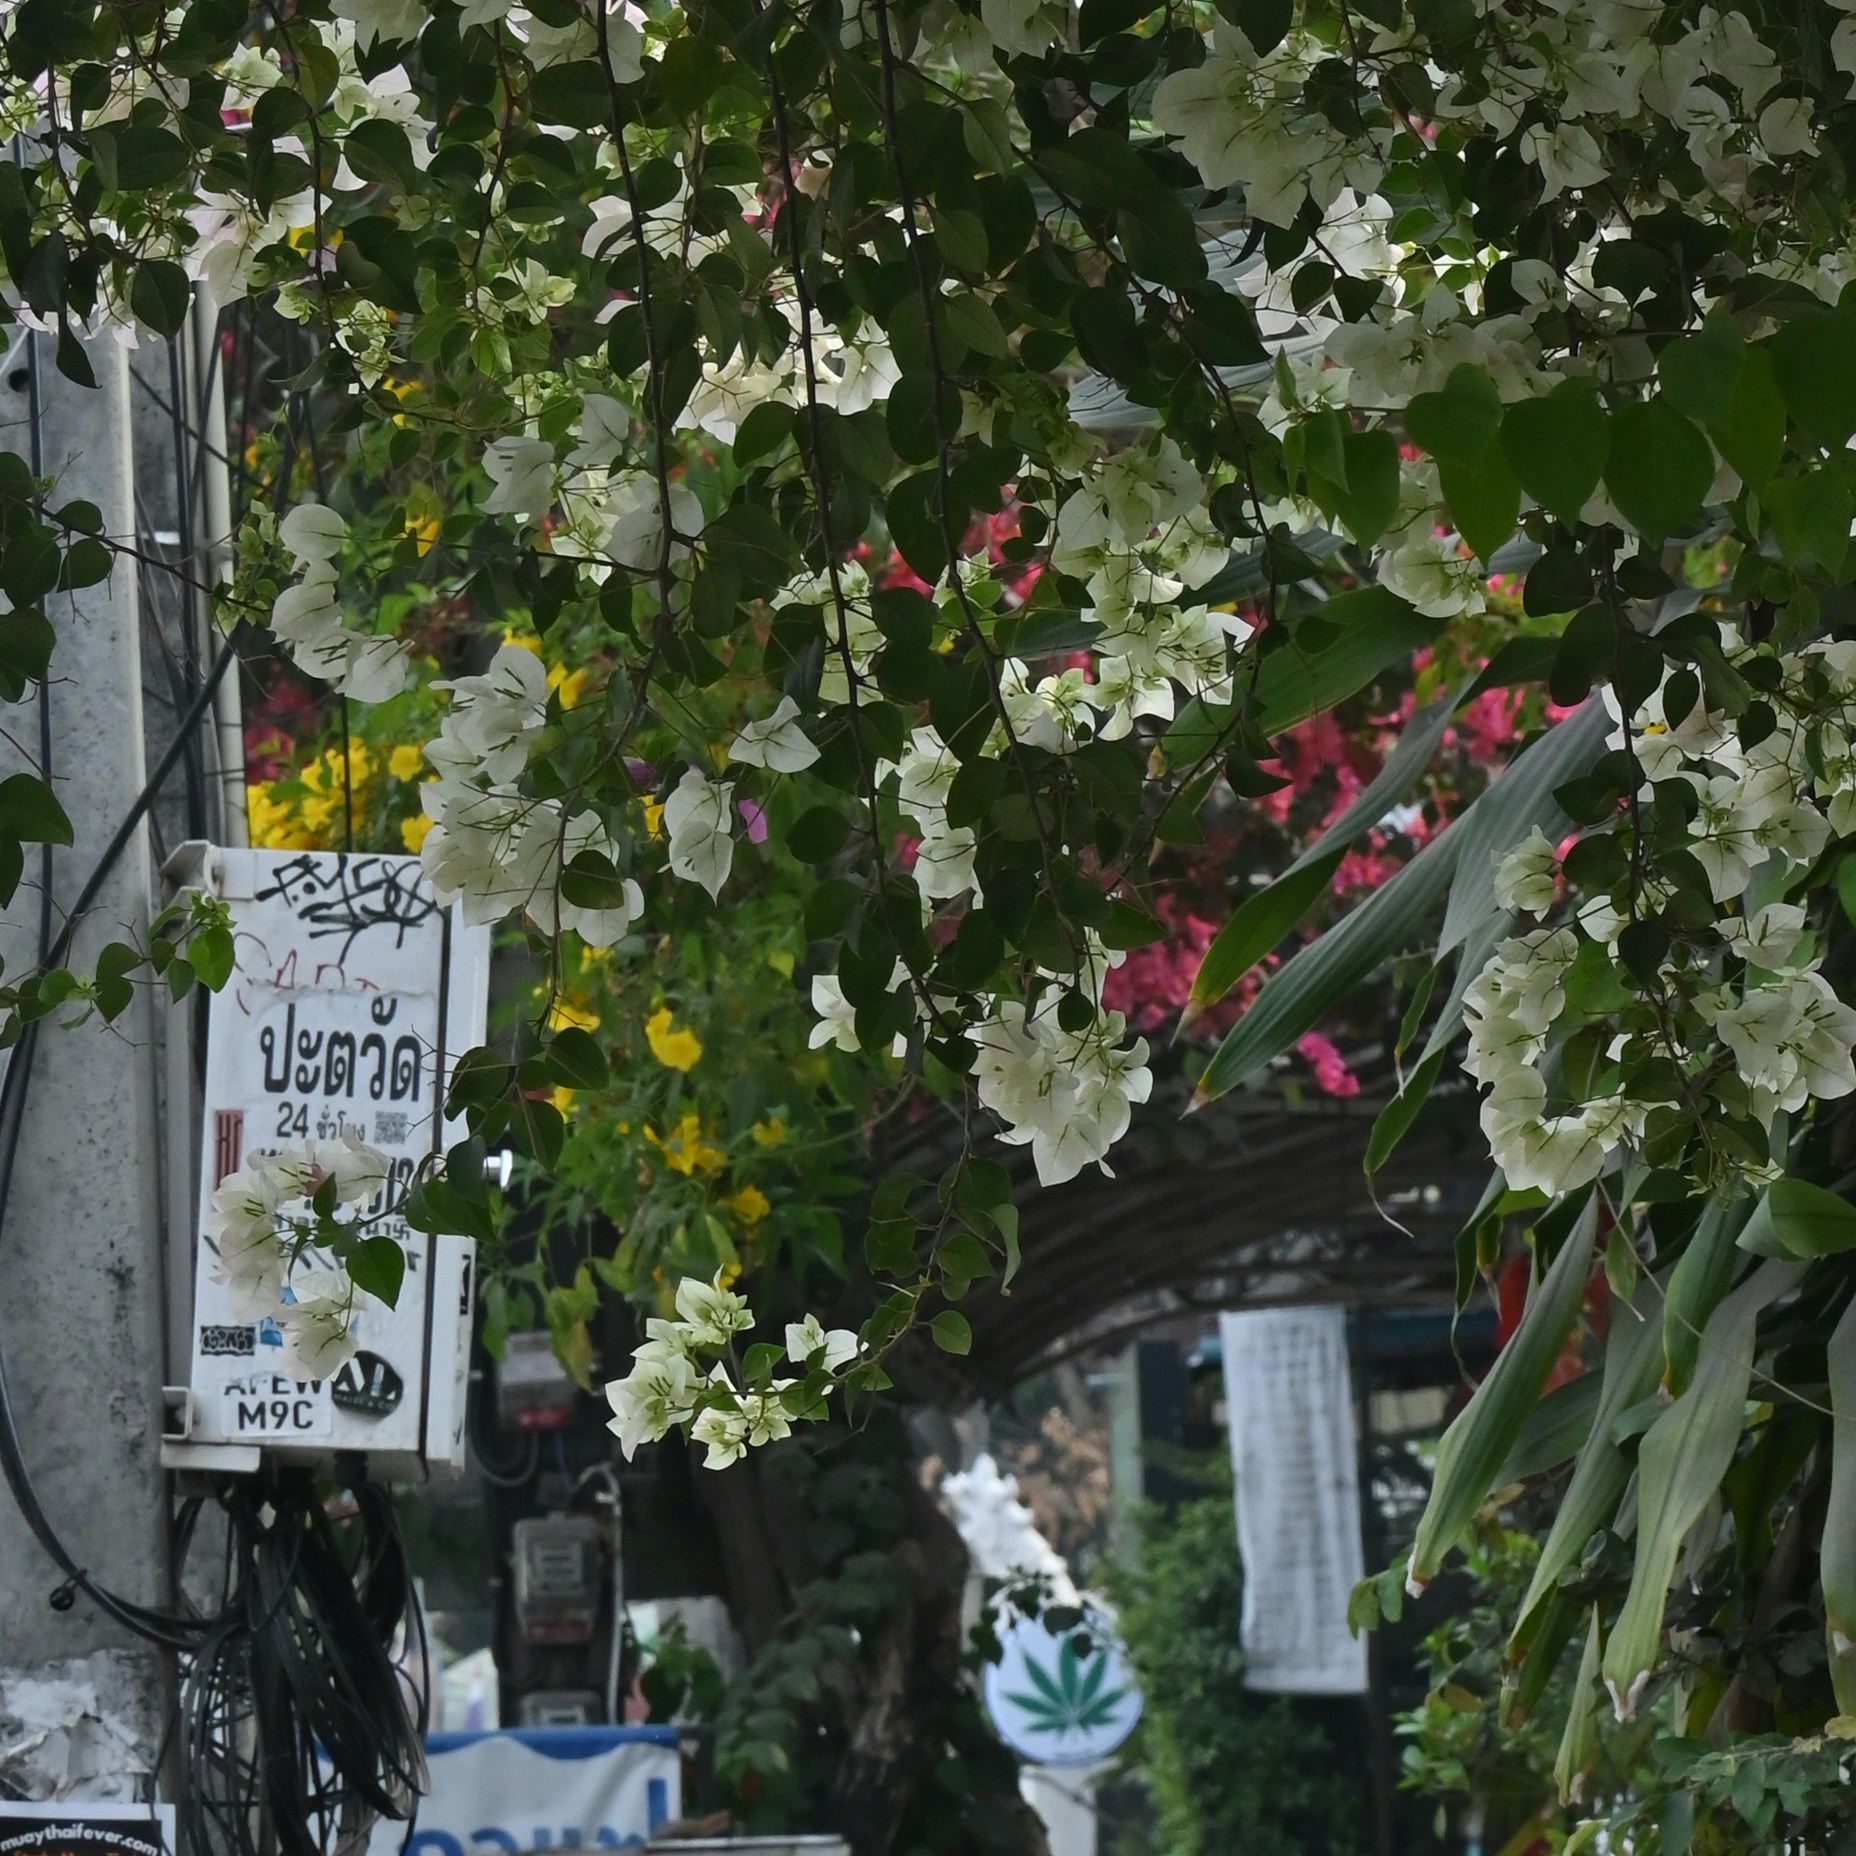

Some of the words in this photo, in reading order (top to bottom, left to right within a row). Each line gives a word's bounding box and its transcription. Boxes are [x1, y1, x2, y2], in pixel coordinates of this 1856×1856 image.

[260, 996, 423, 1102] ปะตวัด
[277, 1101, 308, 1138] 24
[316, 1103, 366, 1142] ชั่วโง
[238, 1400, 314, 1431] M9C
